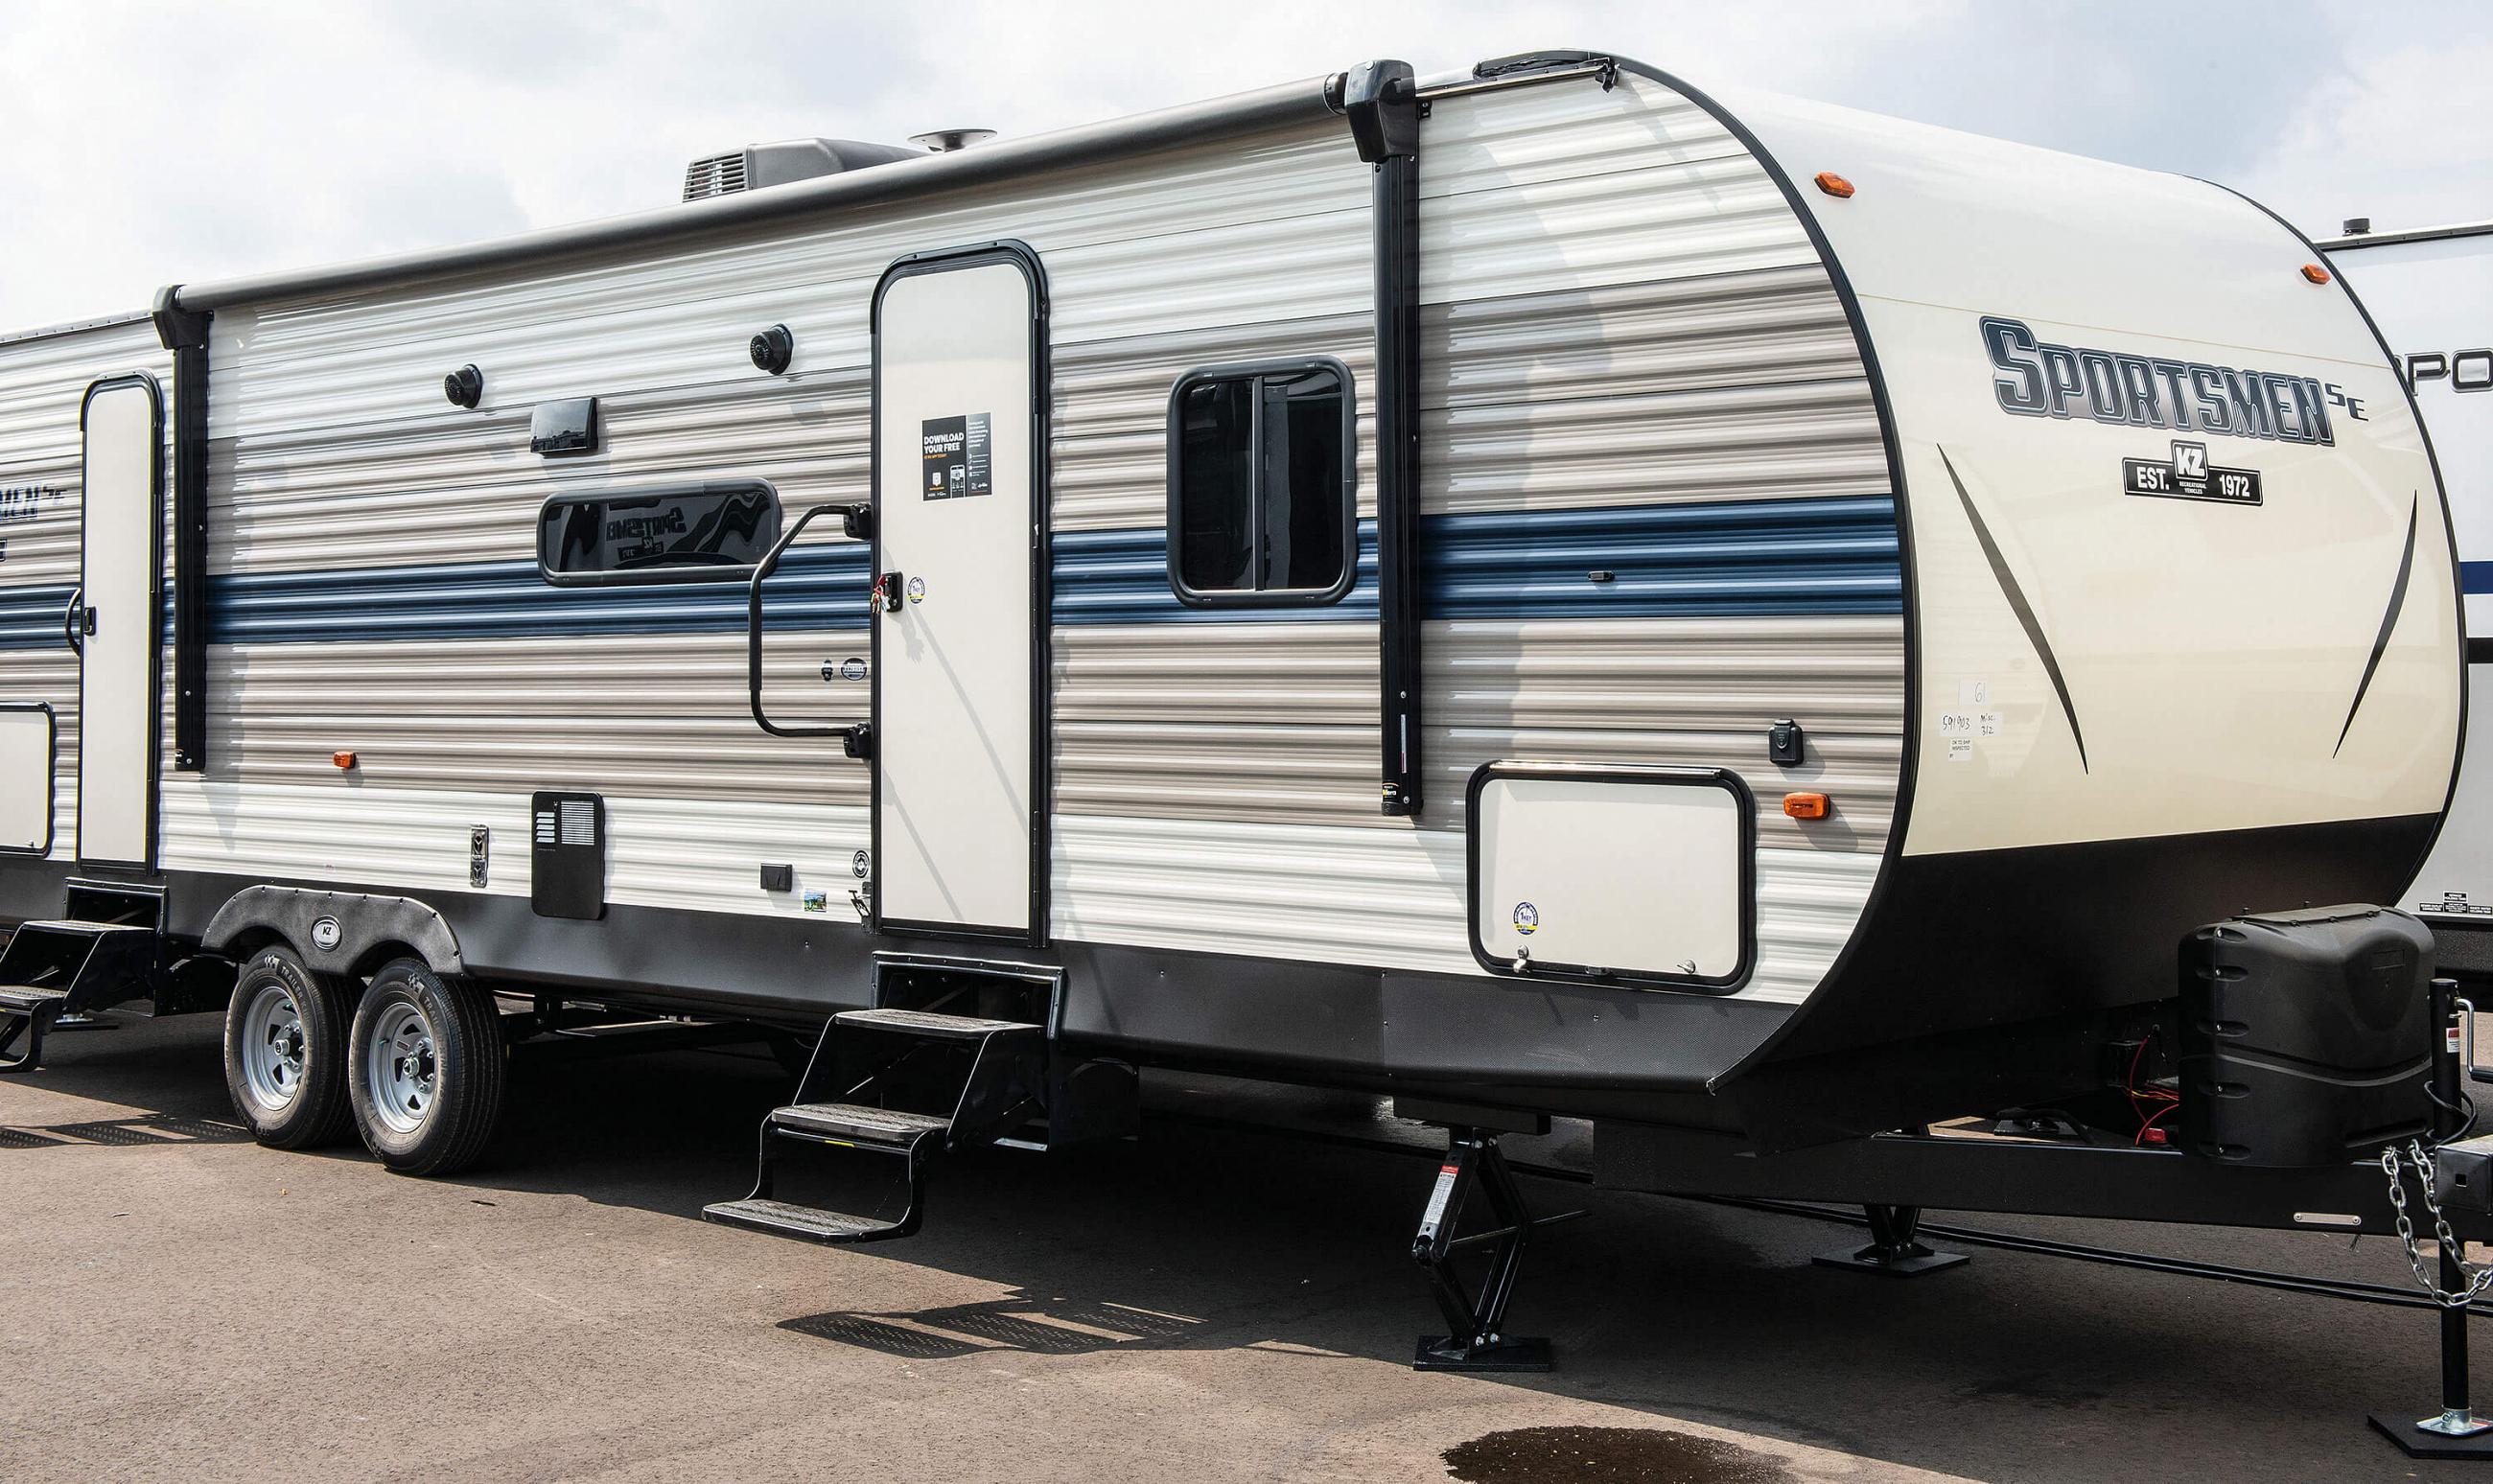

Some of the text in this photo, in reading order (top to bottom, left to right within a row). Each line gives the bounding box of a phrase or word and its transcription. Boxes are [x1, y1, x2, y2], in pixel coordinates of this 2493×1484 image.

[924, 432, 965, 445] DOWNLOAD
[923, 442, 961, 453] YOUR FREE
[2175, 446, 2205, 477] KZ
[2136, 466, 2250, 497] EST. 1972
[322, 925, 332, 936] KZ
